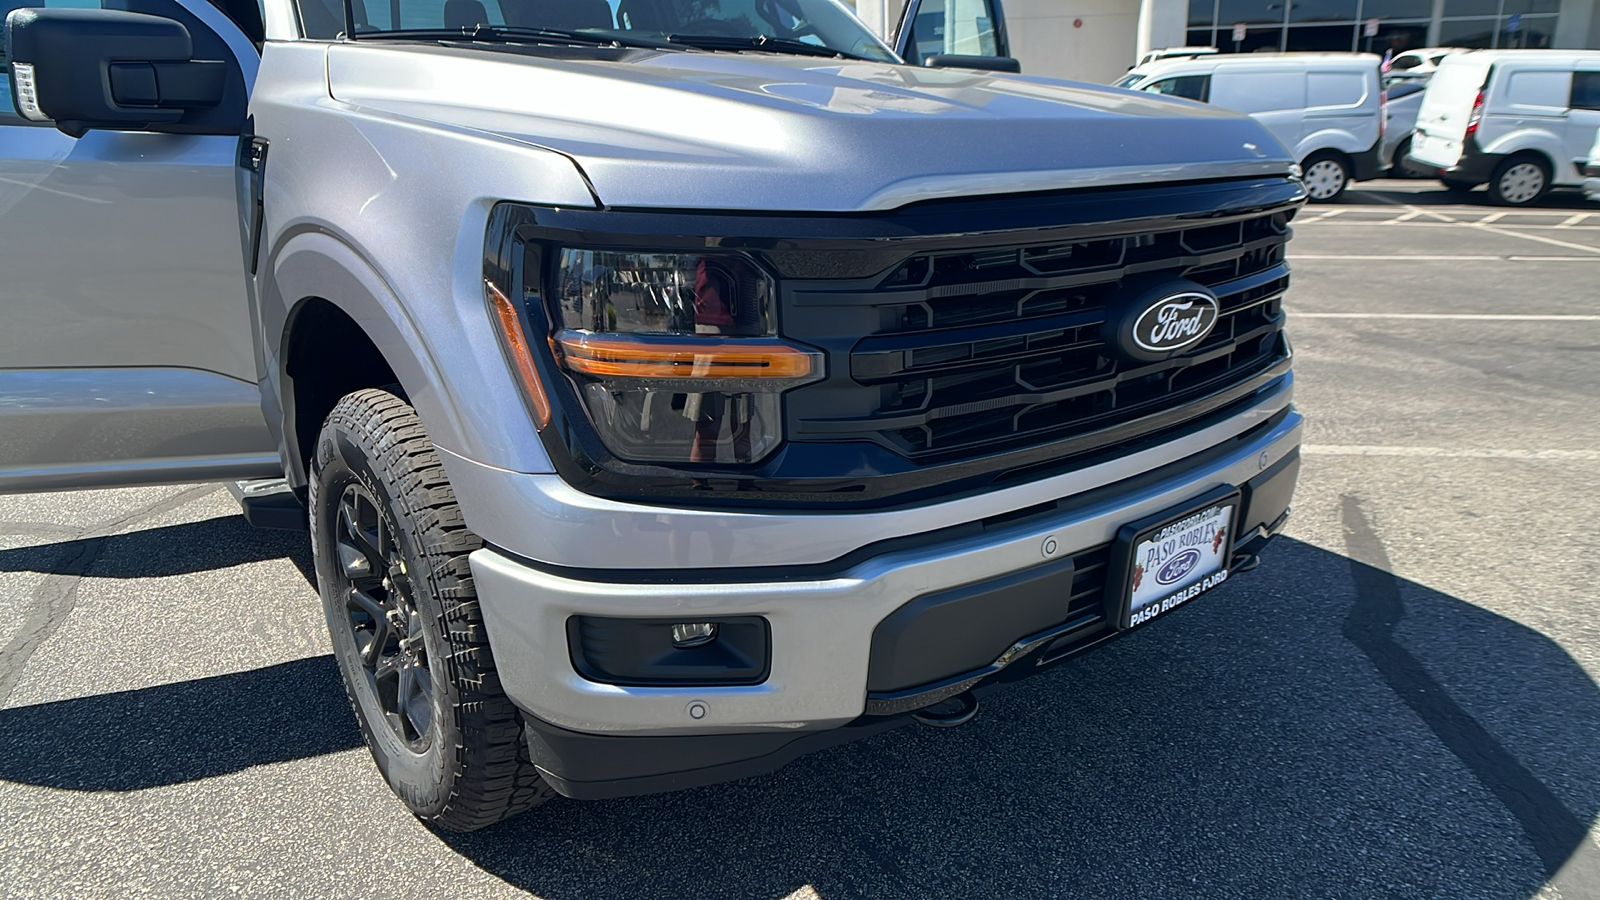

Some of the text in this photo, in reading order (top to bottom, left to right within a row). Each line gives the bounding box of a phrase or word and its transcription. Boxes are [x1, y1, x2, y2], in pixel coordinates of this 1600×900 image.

[1150, 301, 1205, 344] Ford
[1145, 520, 1218, 574] PASO ROBLES
[1165, 554, 1194, 581] Ford
[1129, 569, 1228, 628] PASO ROBLES FORD
